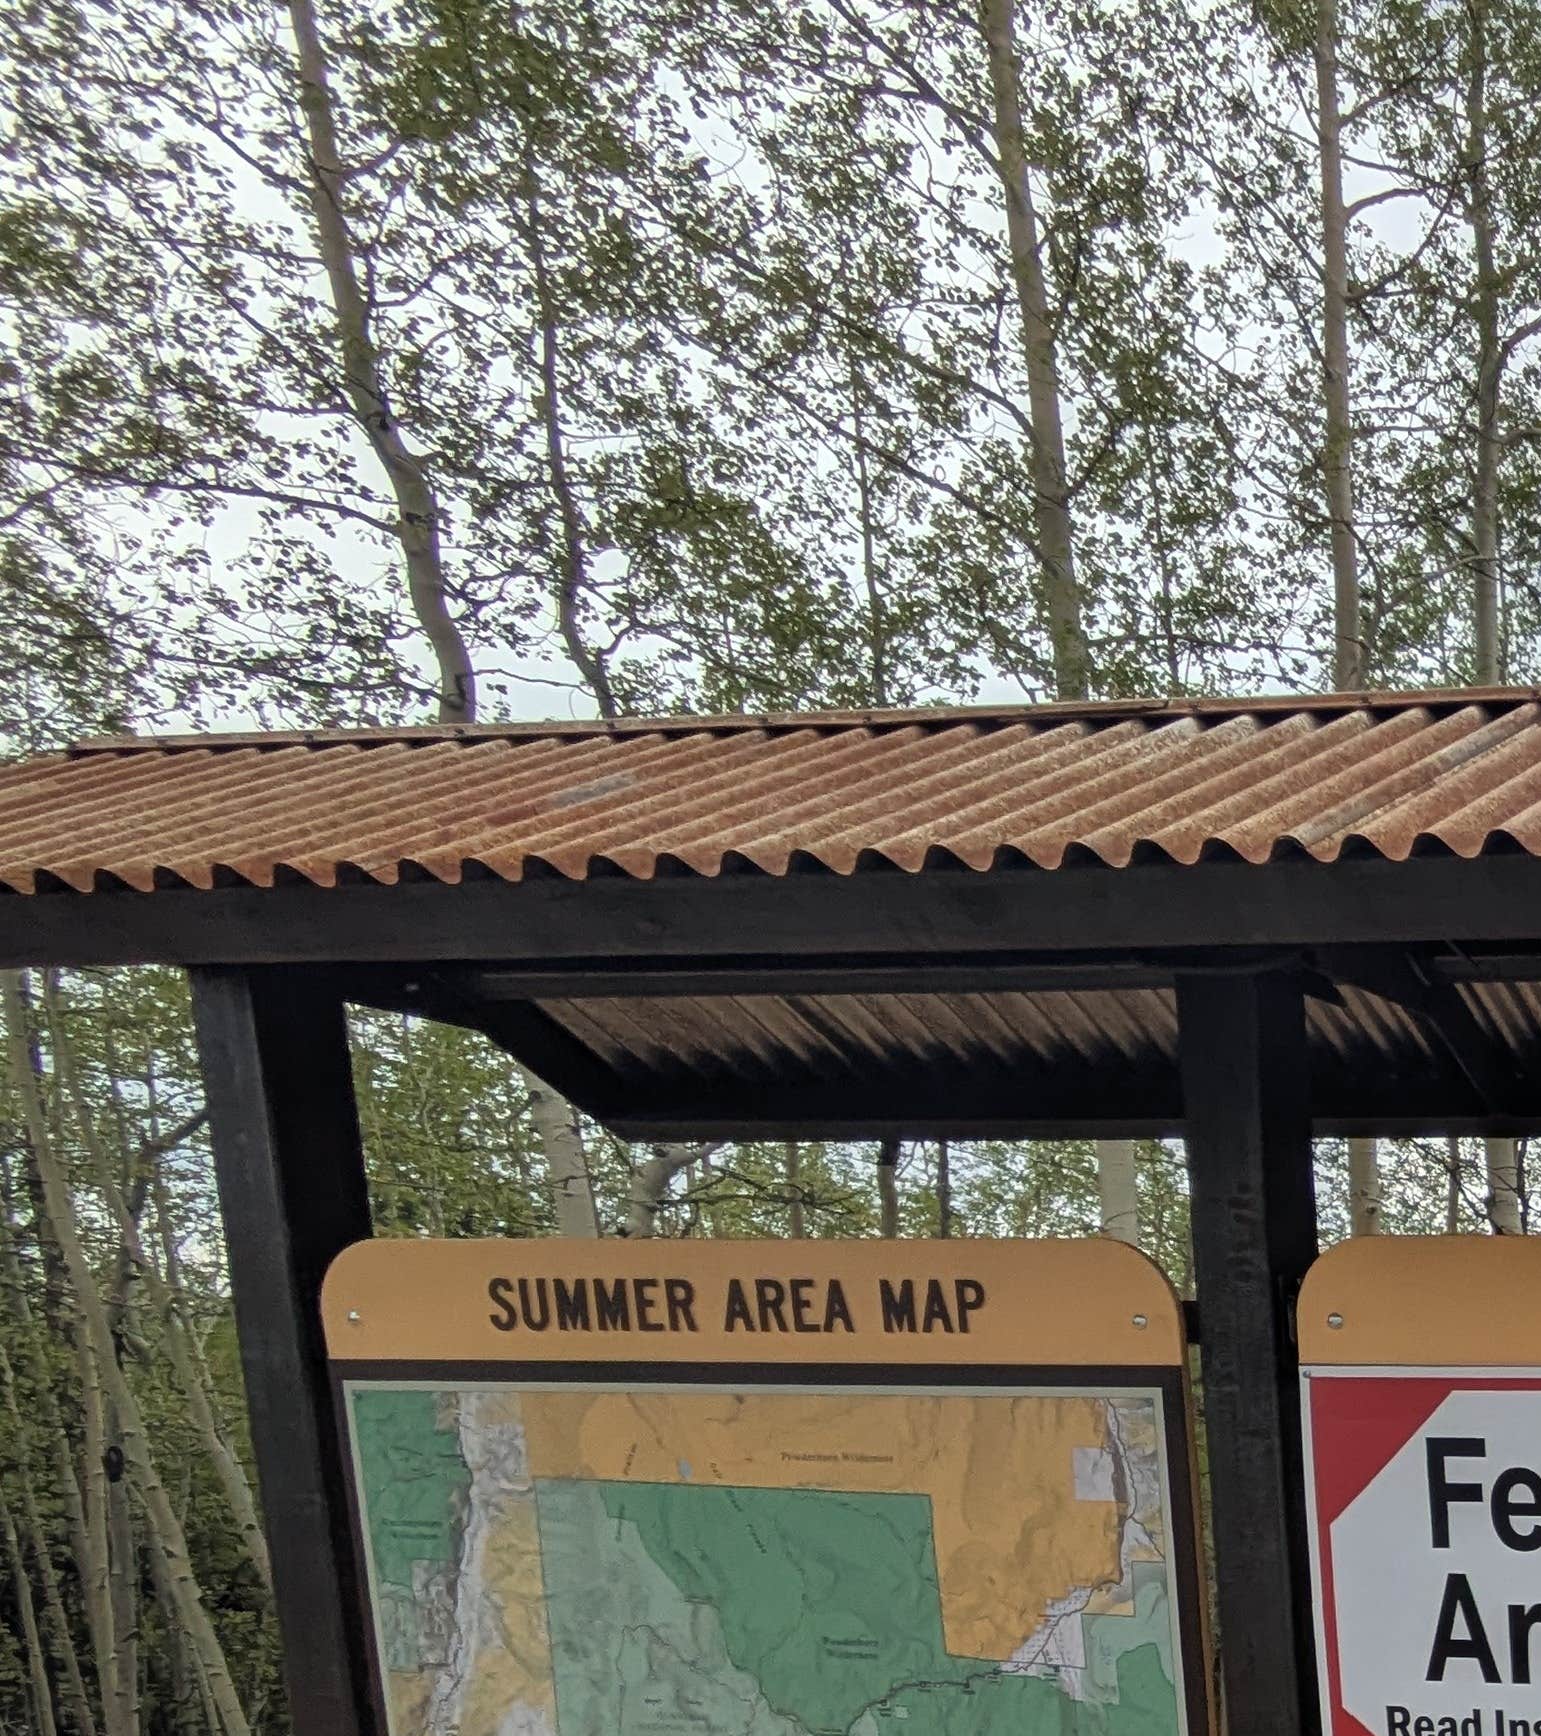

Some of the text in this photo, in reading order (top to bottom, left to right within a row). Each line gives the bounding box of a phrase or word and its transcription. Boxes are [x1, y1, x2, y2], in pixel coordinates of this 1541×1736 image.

[488, 1277, 986, 1333] SUMMER AREA MAP
